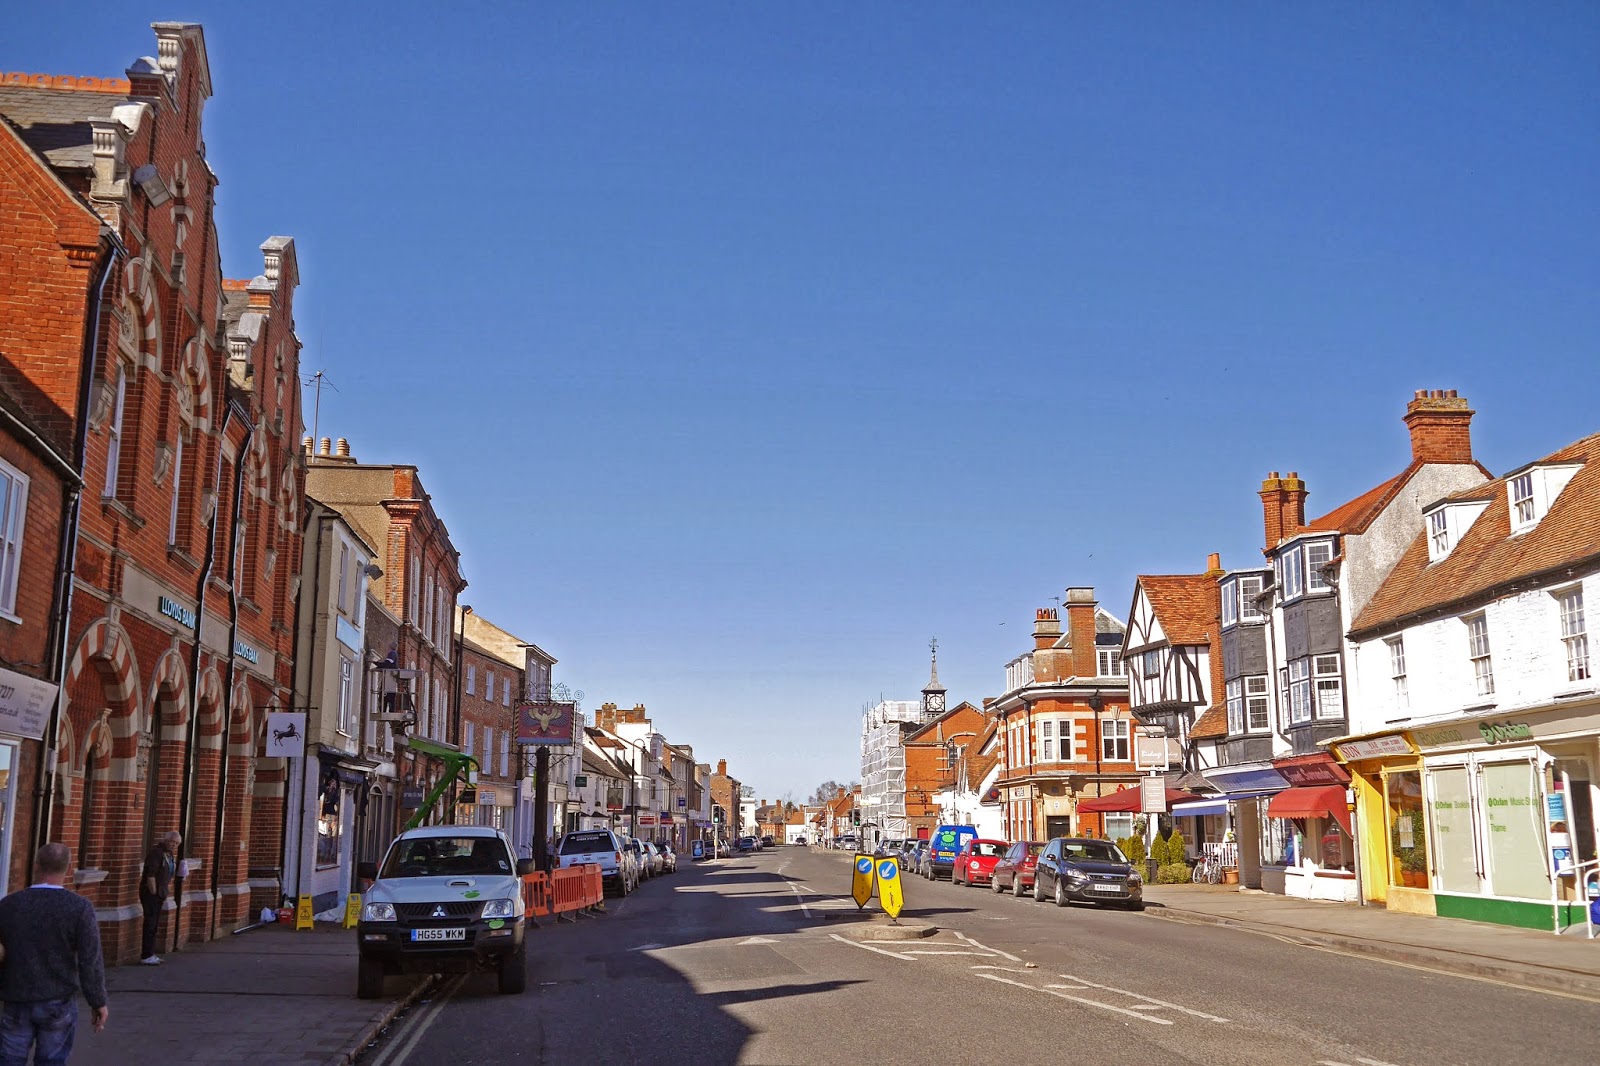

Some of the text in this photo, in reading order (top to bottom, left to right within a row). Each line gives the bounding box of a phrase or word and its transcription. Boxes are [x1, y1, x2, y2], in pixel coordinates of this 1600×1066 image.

[161, 596, 197, 630] LLOYDS BANK
[1418, 729, 1463, 746] Bookshop
[1490, 721, 1532, 740] Oxfam
[1341, 745, 1361, 759] SUN
[1493, 798, 1508, 806] Oxfam
[1510, 797, 1524, 806] Music
[1490, 823, 1506, 832] Thame
[417, 929, 464, 939] HG55 WKM
